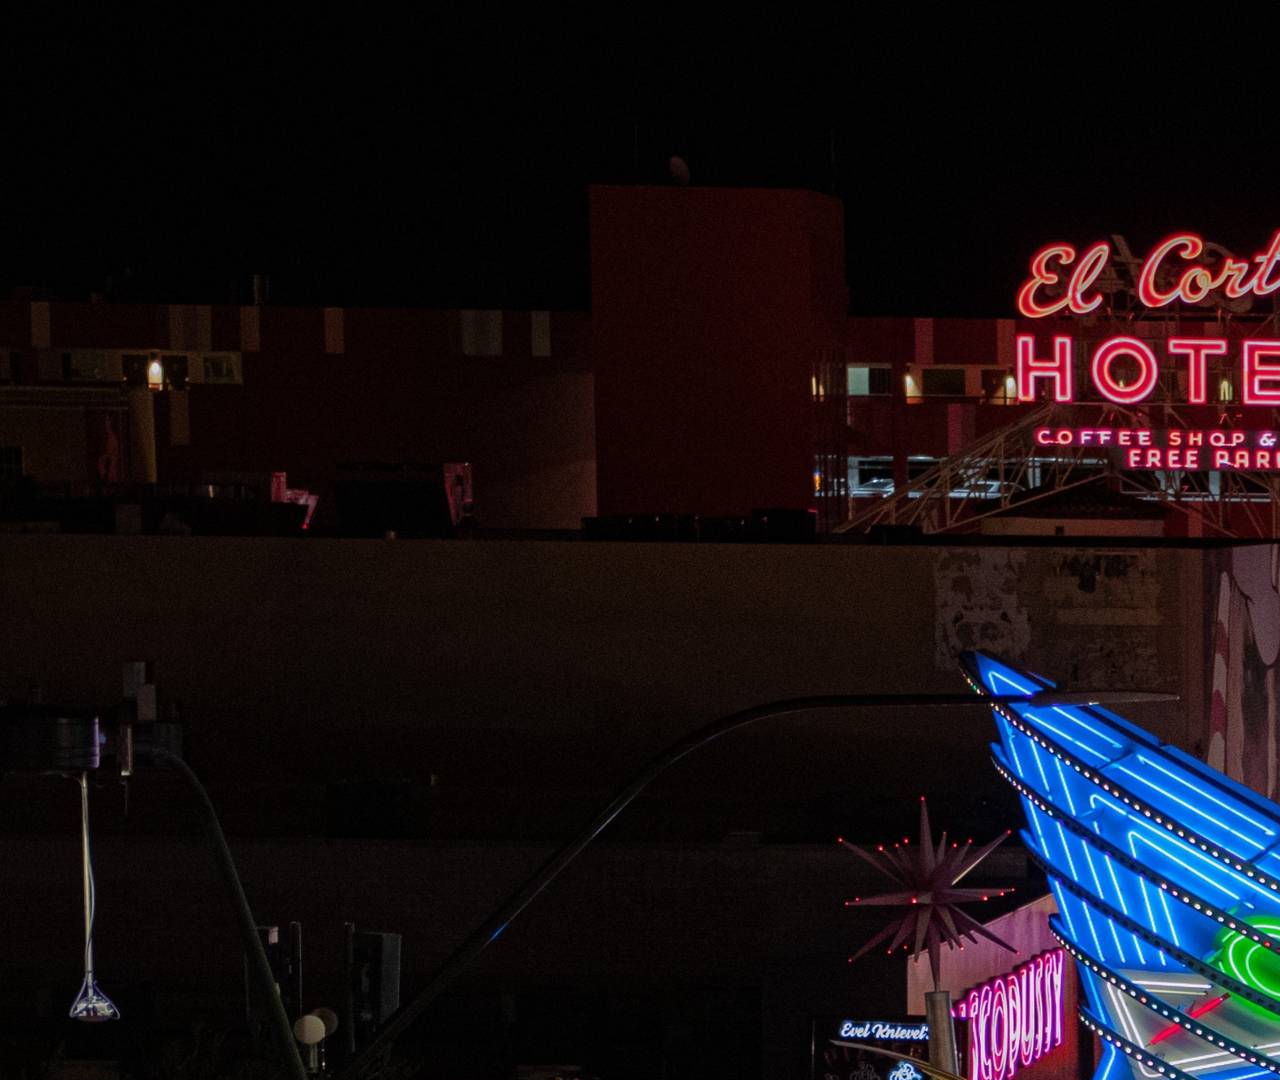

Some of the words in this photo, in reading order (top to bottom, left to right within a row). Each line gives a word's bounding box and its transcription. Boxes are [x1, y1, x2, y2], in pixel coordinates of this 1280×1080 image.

[1018, 242, 1109, 318] El
[1038, 430, 1152, 447] COFFEE
[1168, 431, 1246, 448] SHOP
[1258, 432, 1278, 447] &
[1129, 449, 1199, 469] FREE
[840, 1020, 871, 1039] Evel
